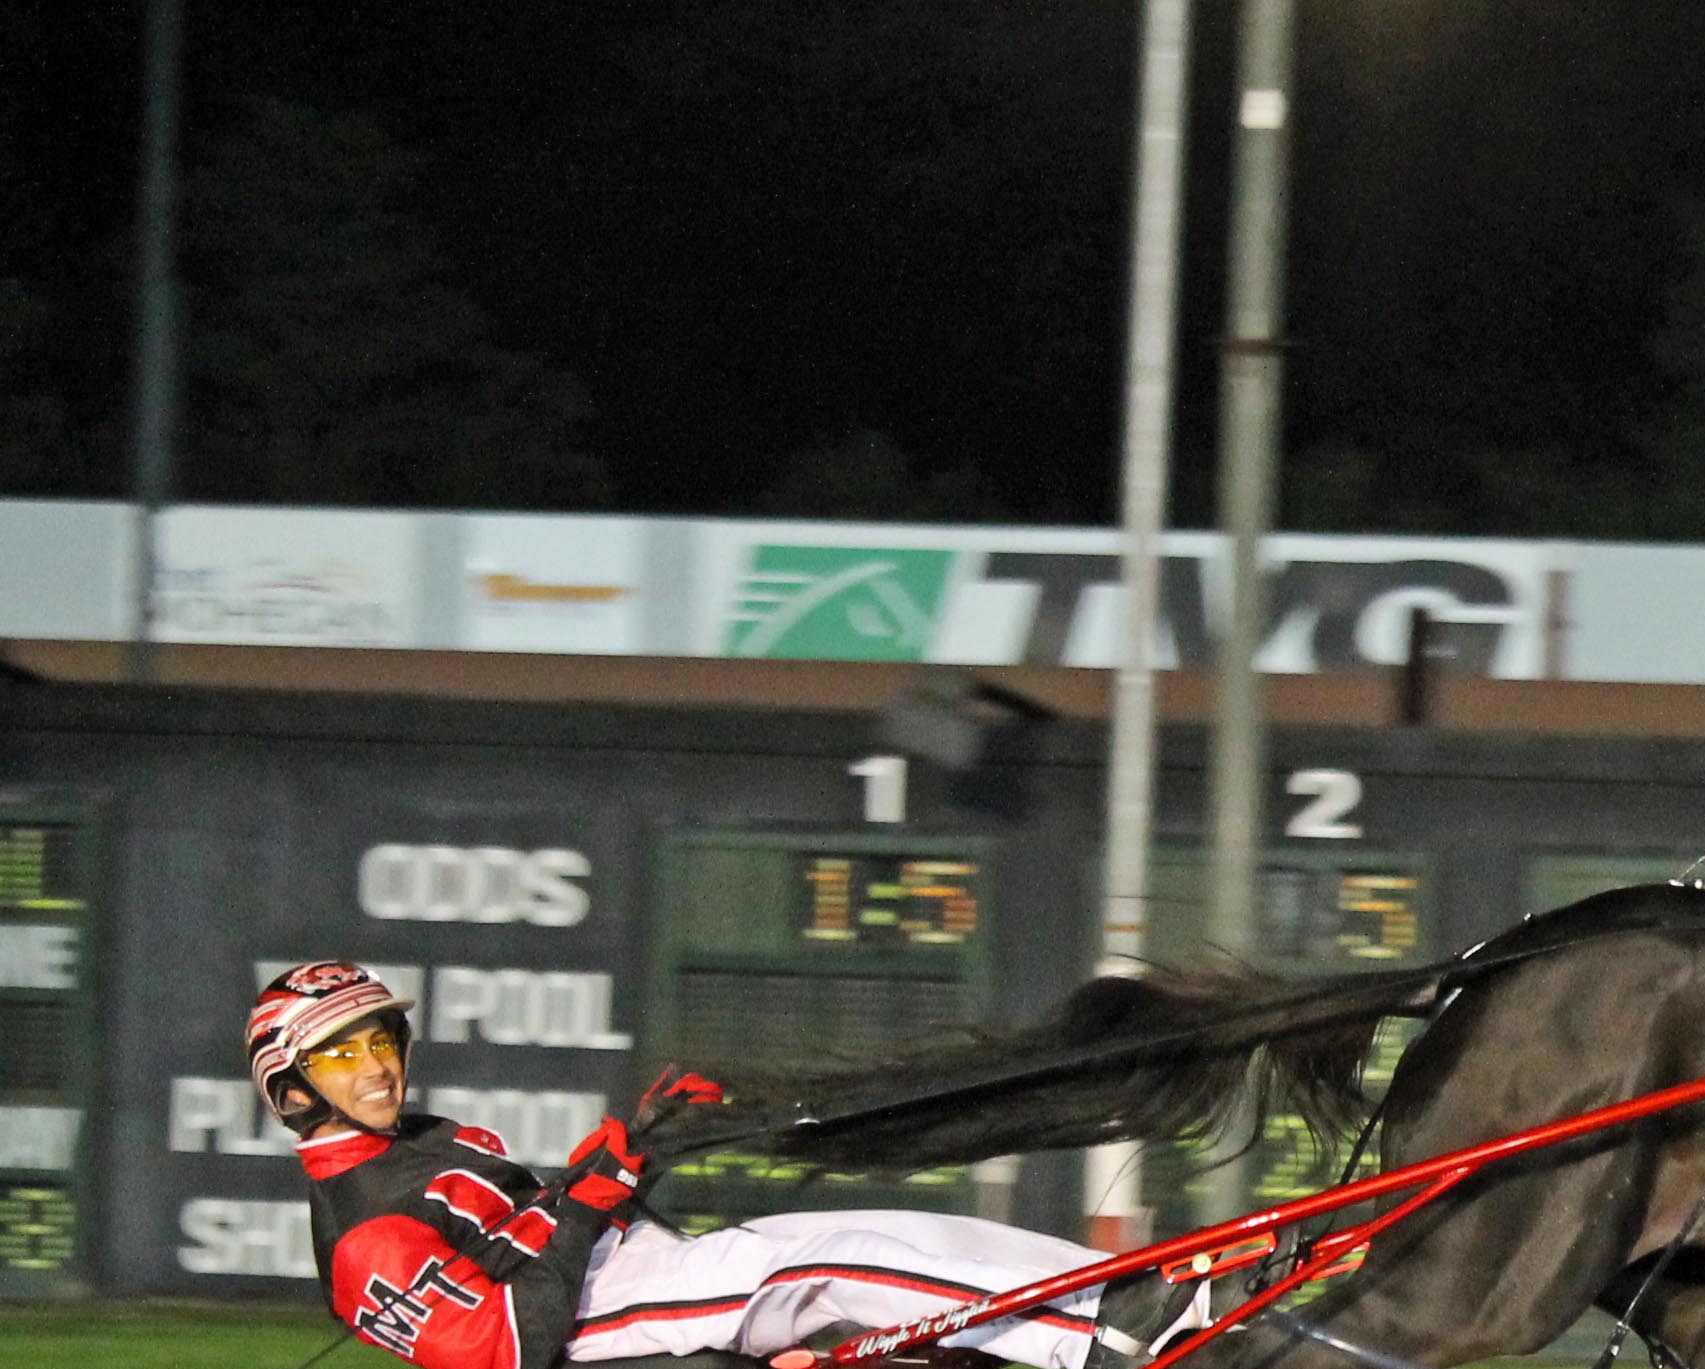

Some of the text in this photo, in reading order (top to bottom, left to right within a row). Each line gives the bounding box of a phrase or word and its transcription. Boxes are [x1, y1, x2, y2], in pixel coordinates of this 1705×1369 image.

[848, 756, 907, 823] 1
[1285, 769, 1363, 839] 2
[358, 843, 592, 927] ODDS
[430, 966, 633, 1051] POOL
